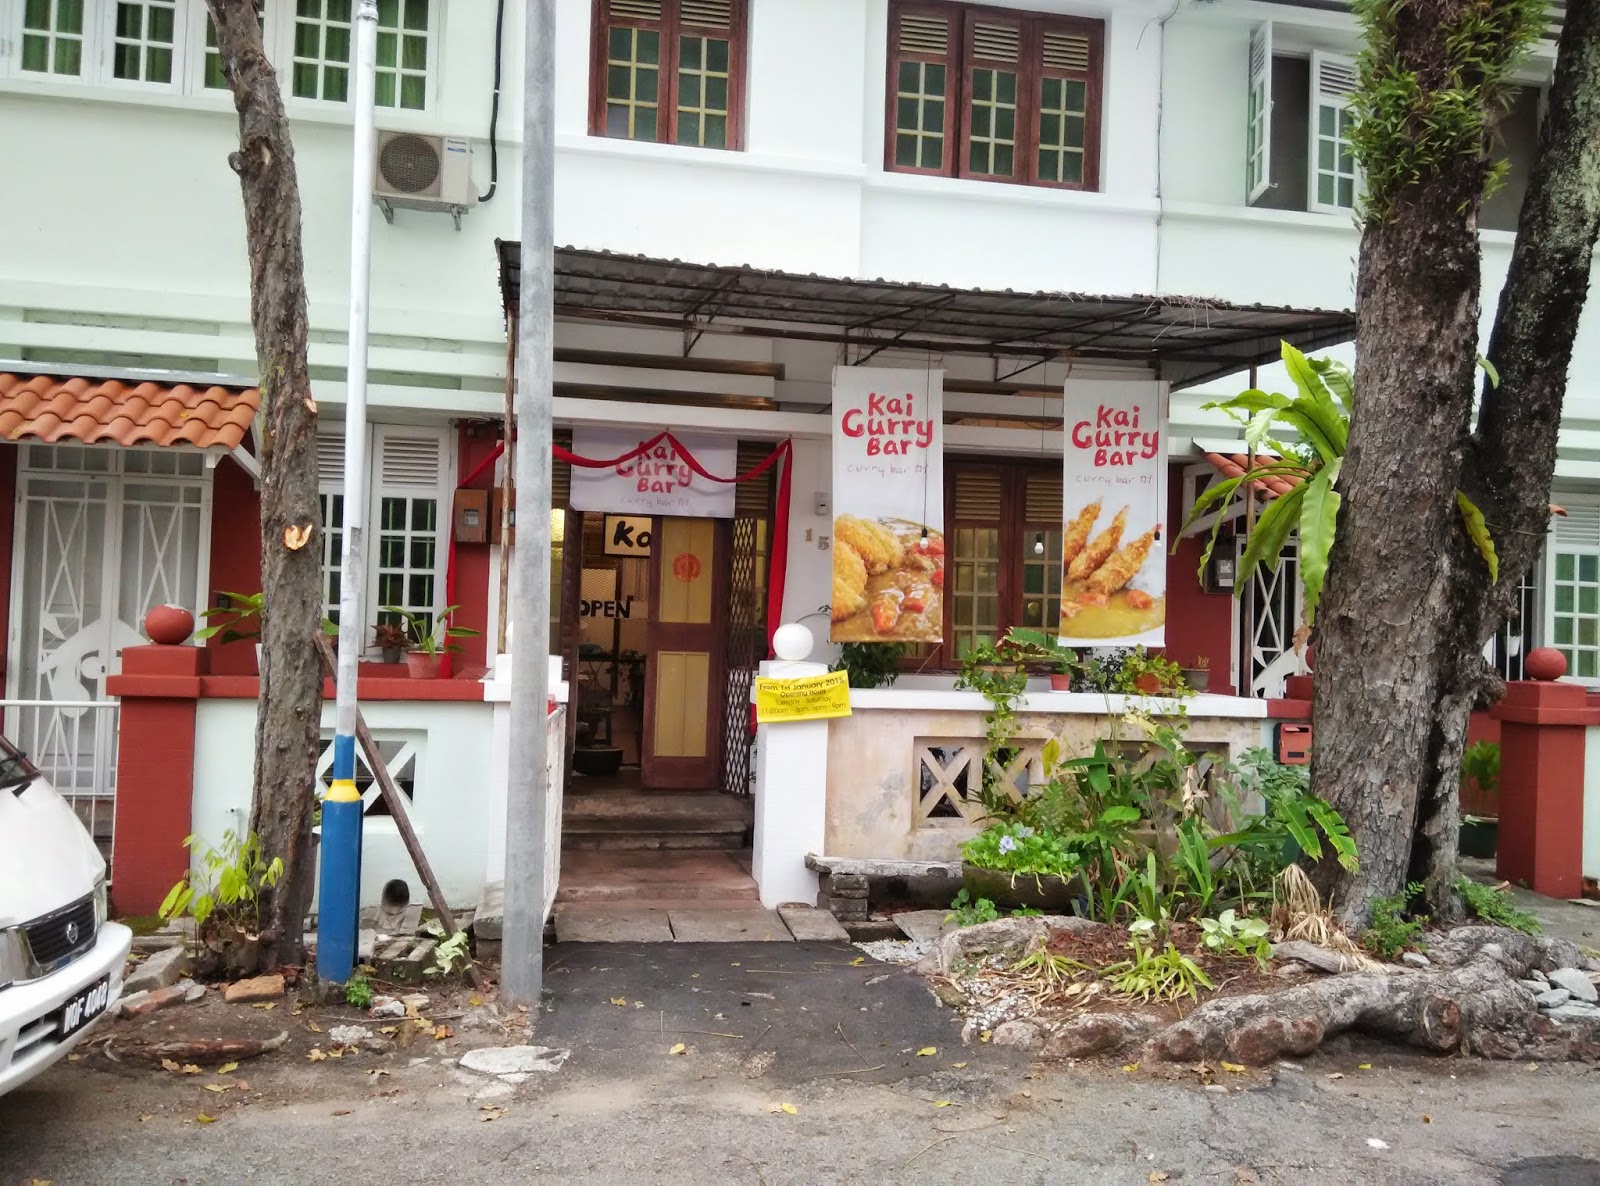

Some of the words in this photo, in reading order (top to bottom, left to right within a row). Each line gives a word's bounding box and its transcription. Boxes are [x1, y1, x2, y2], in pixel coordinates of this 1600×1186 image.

[868, 392, 913, 417] Kai
[1096, 404, 1140, 429] Kai
[842, 408, 934, 448] Curry
[866, 436, 913, 456] Bar
[1072, 420, 1159, 459] Curry
[1094, 448, 1138, 467] Bar
[637, 476, 677, 494] Bar
[1075, 474, 1111, 487] curry
[1116, 474, 1135, 484] bar
[759, 683, 778, 691] From
[793, 681, 823, 690] January
